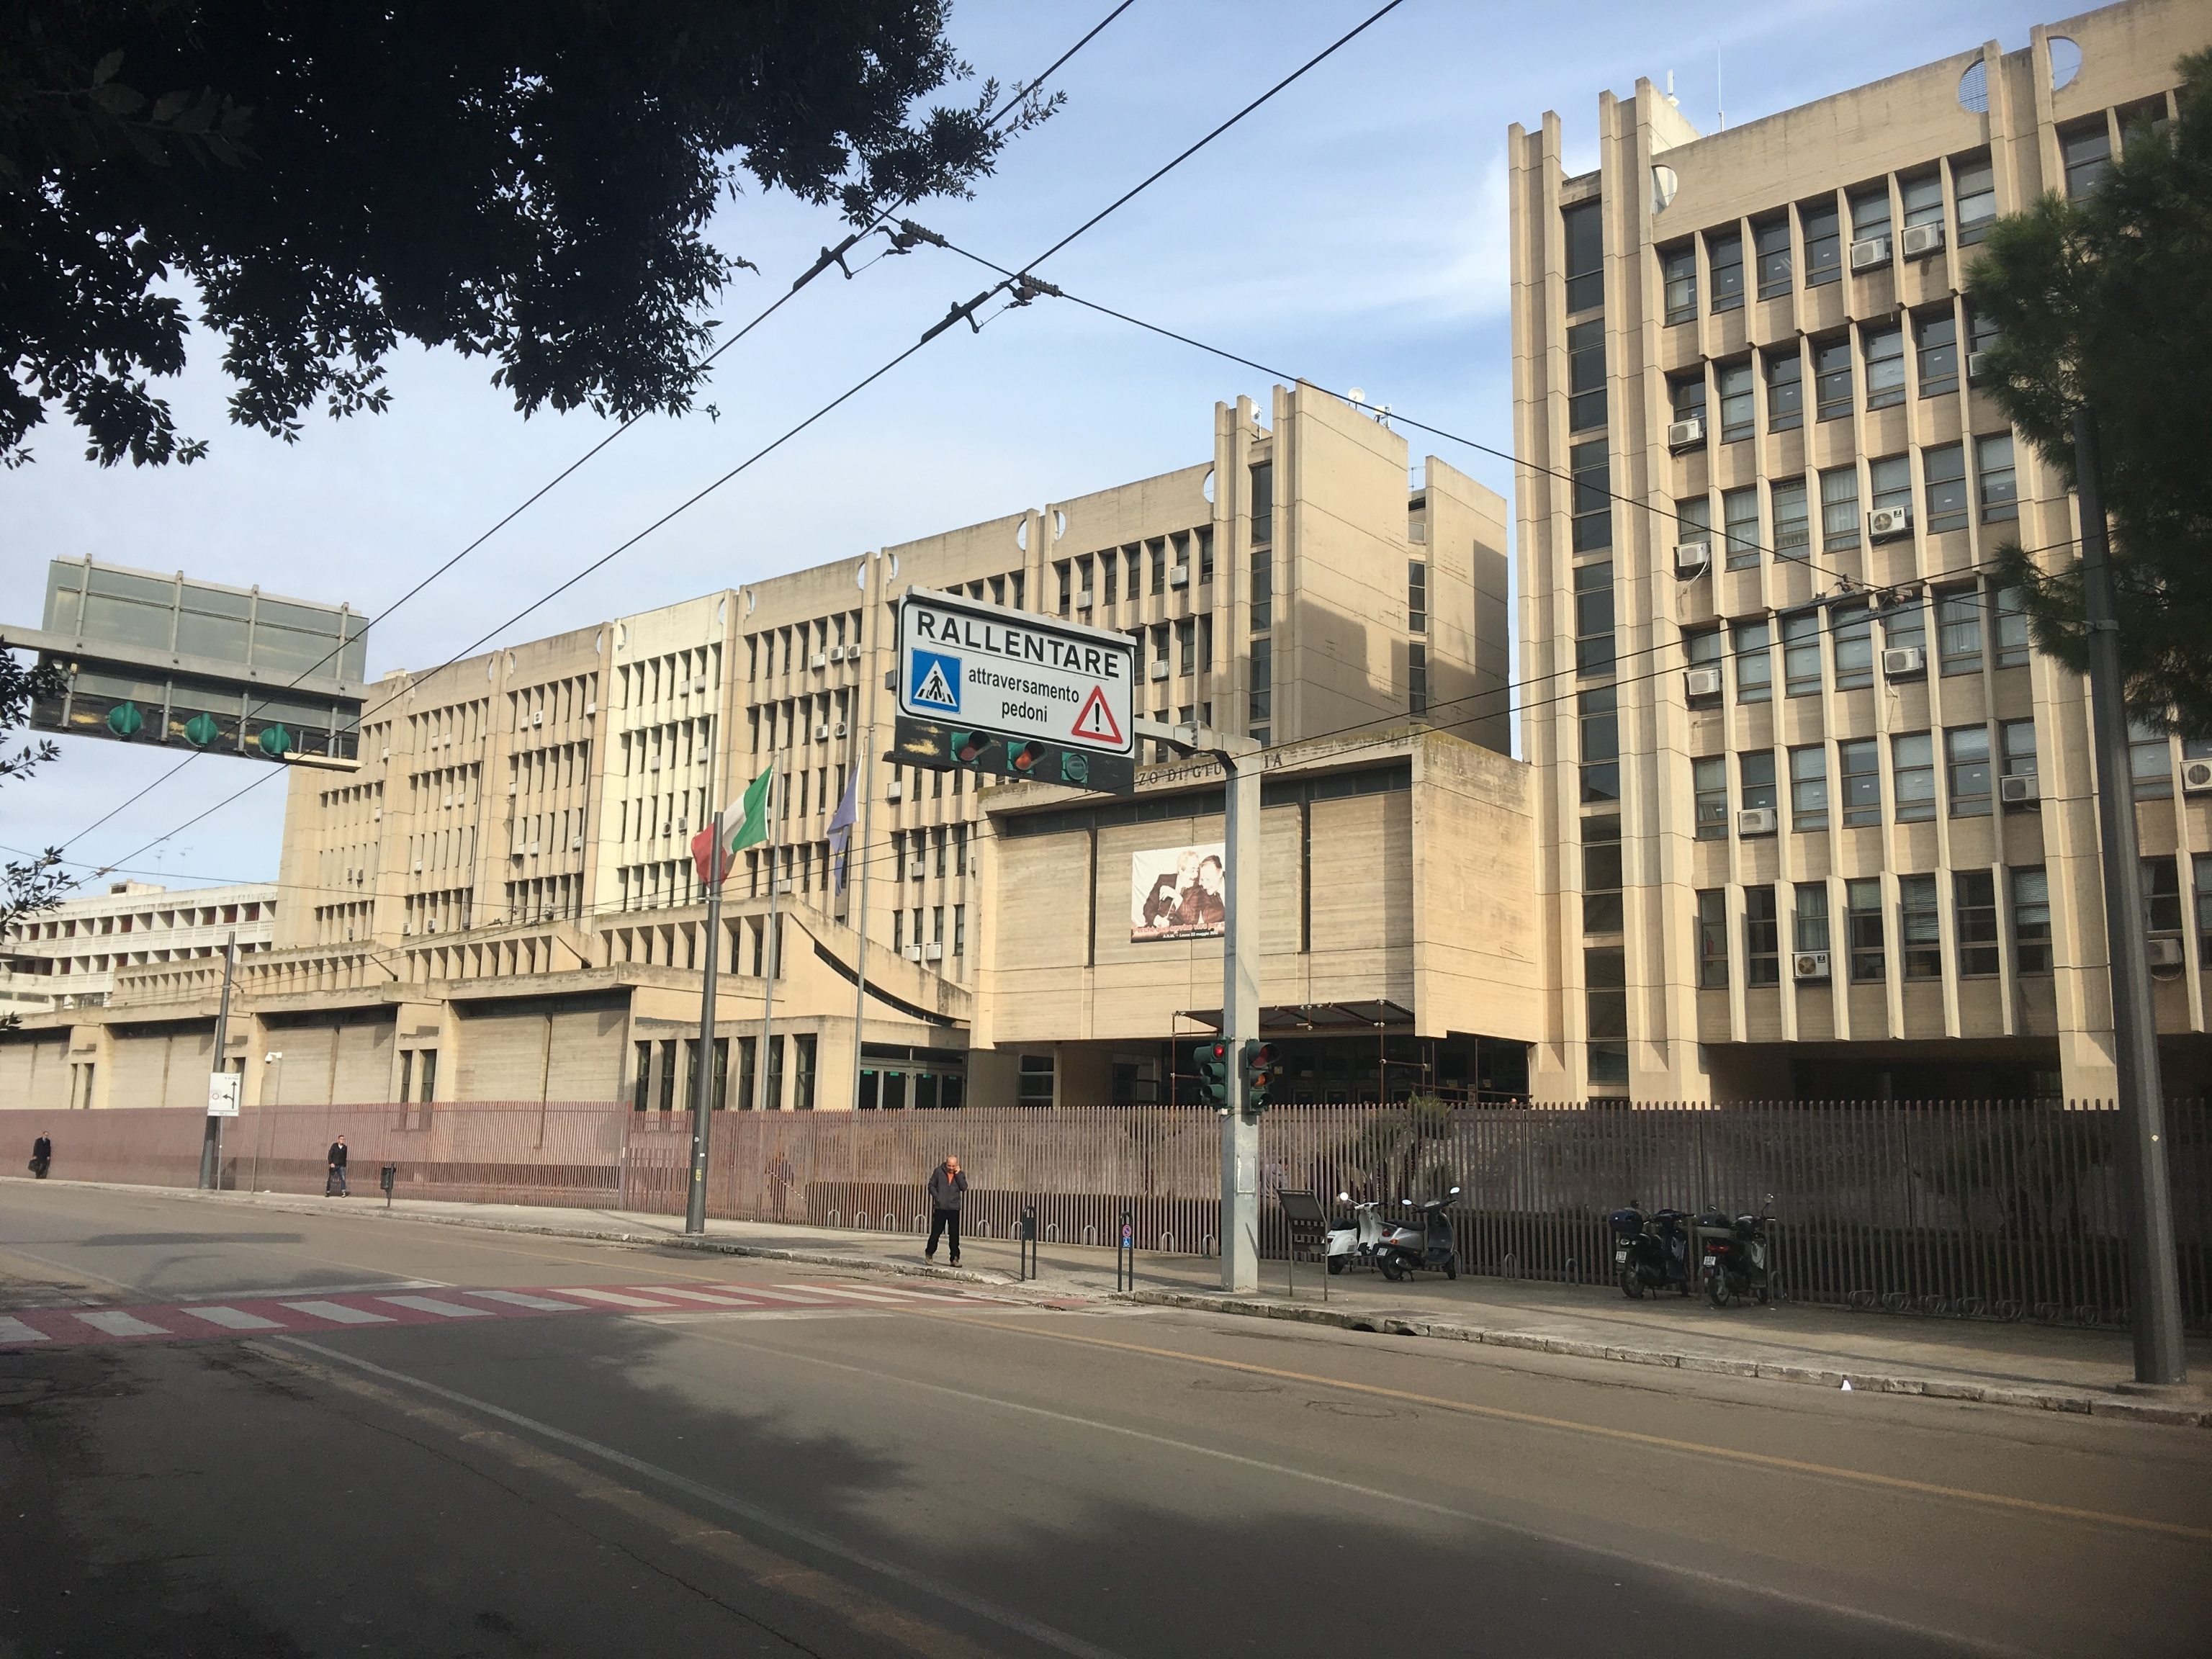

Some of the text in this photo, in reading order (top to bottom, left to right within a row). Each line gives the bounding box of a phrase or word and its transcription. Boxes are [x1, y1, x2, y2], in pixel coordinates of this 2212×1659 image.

[917, 611, 1120, 678] RALLENTARE
[968, 667, 1079, 703] attraversamento
[1002, 701, 1048, 722] pedoni
[1167, 768, 1183, 782] DI
